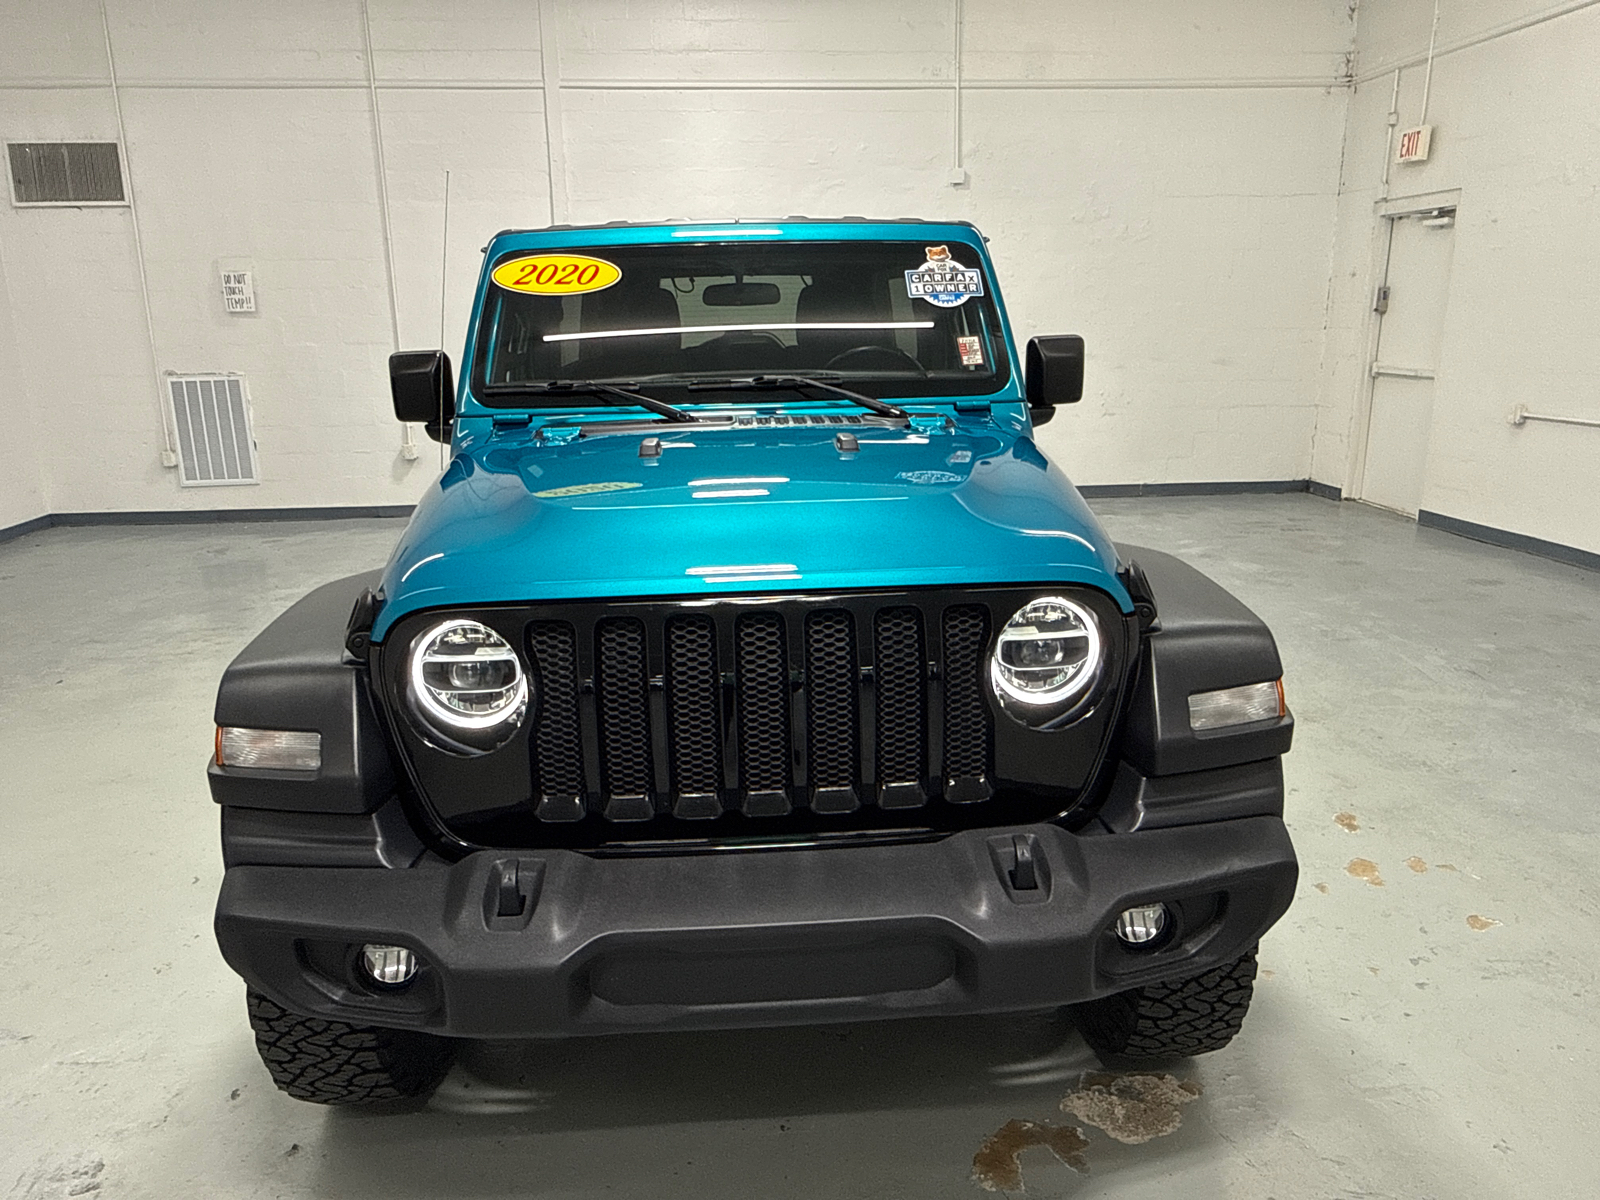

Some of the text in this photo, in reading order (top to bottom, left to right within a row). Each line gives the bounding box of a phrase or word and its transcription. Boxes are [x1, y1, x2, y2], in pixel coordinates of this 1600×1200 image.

[1399, 130, 1422, 158] EXIT
[224, 273, 247, 285] DO NOT
[512, 264, 600, 285] 2020
[911, 273, 975, 283] CARFAX
[224, 286, 244, 296] TOUCH
[924, 284, 977, 293] OWNER
[226, 296, 252, 309] TEMP!!
